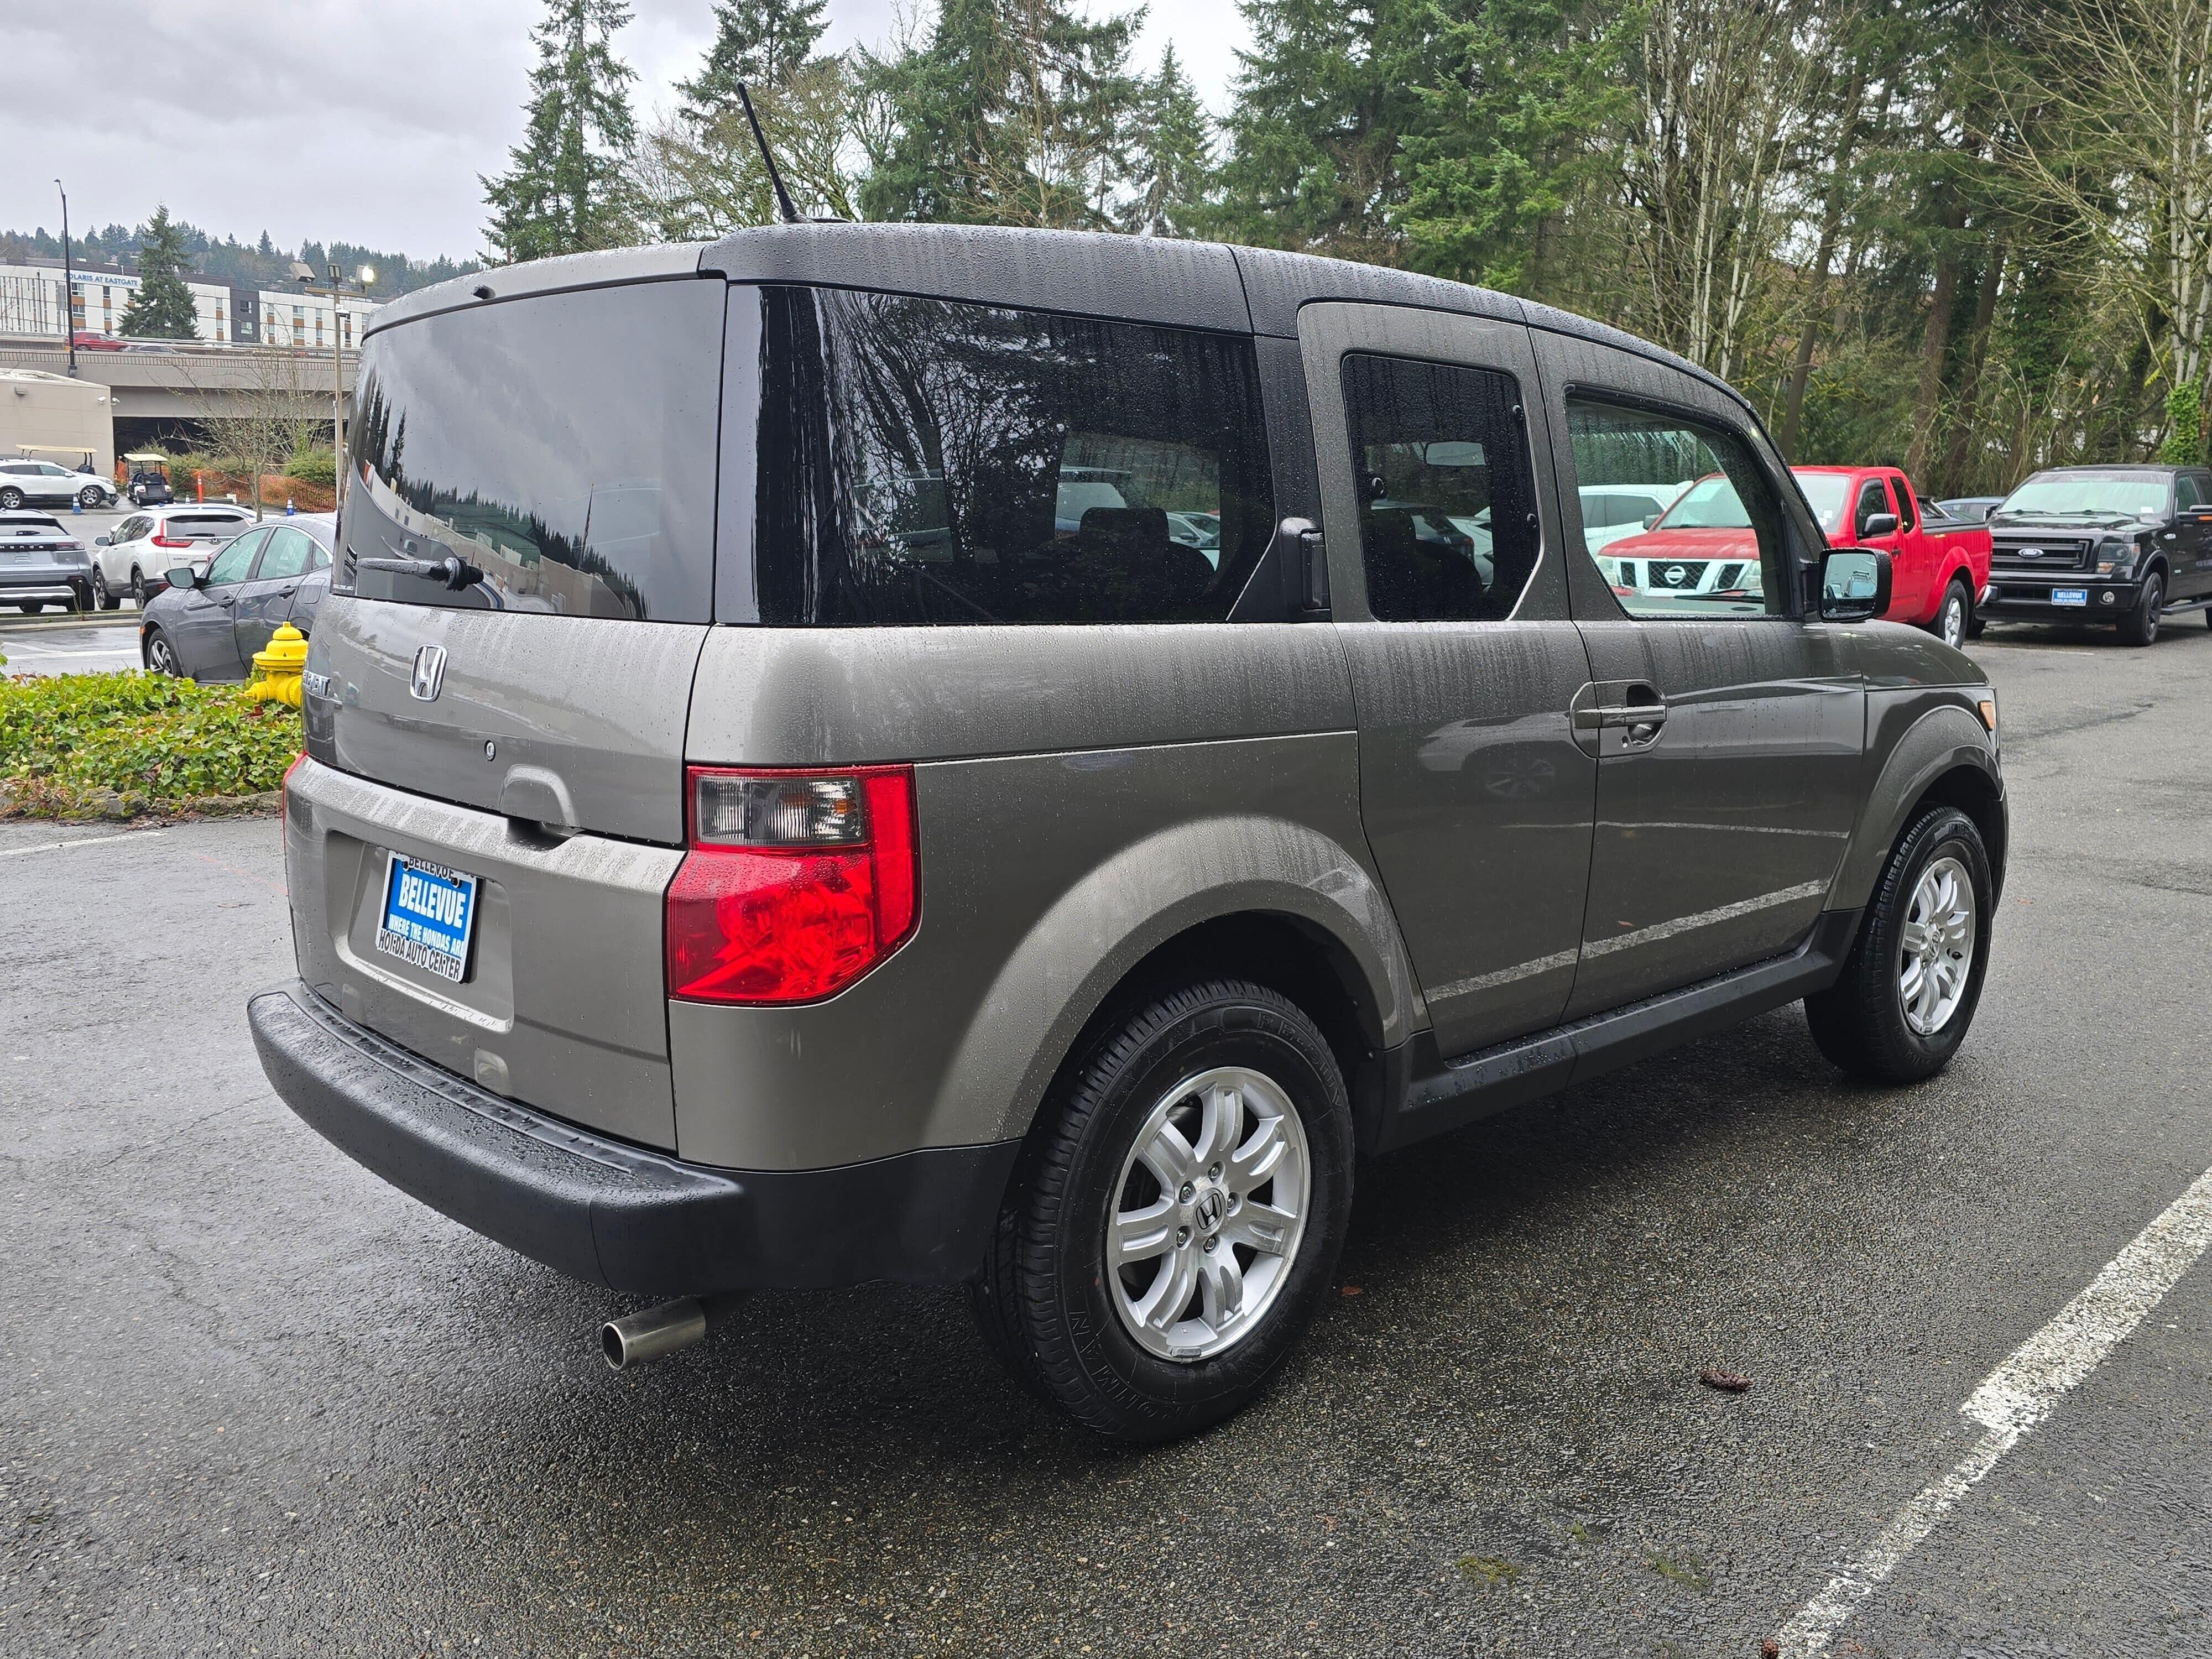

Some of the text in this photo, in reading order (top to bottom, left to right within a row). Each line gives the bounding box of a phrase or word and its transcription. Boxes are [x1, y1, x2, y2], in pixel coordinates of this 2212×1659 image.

[105, 277, 138, 286] EASTGATE
[398, 873, 466, 929] BELLEVUE
[379, 930, 461, 980] HONDA AUTO CENTER
[388, 914, 410, 936] WHERE
[410, 922, 422, 940] THE
[422, 927, 451, 952] HONDAS
